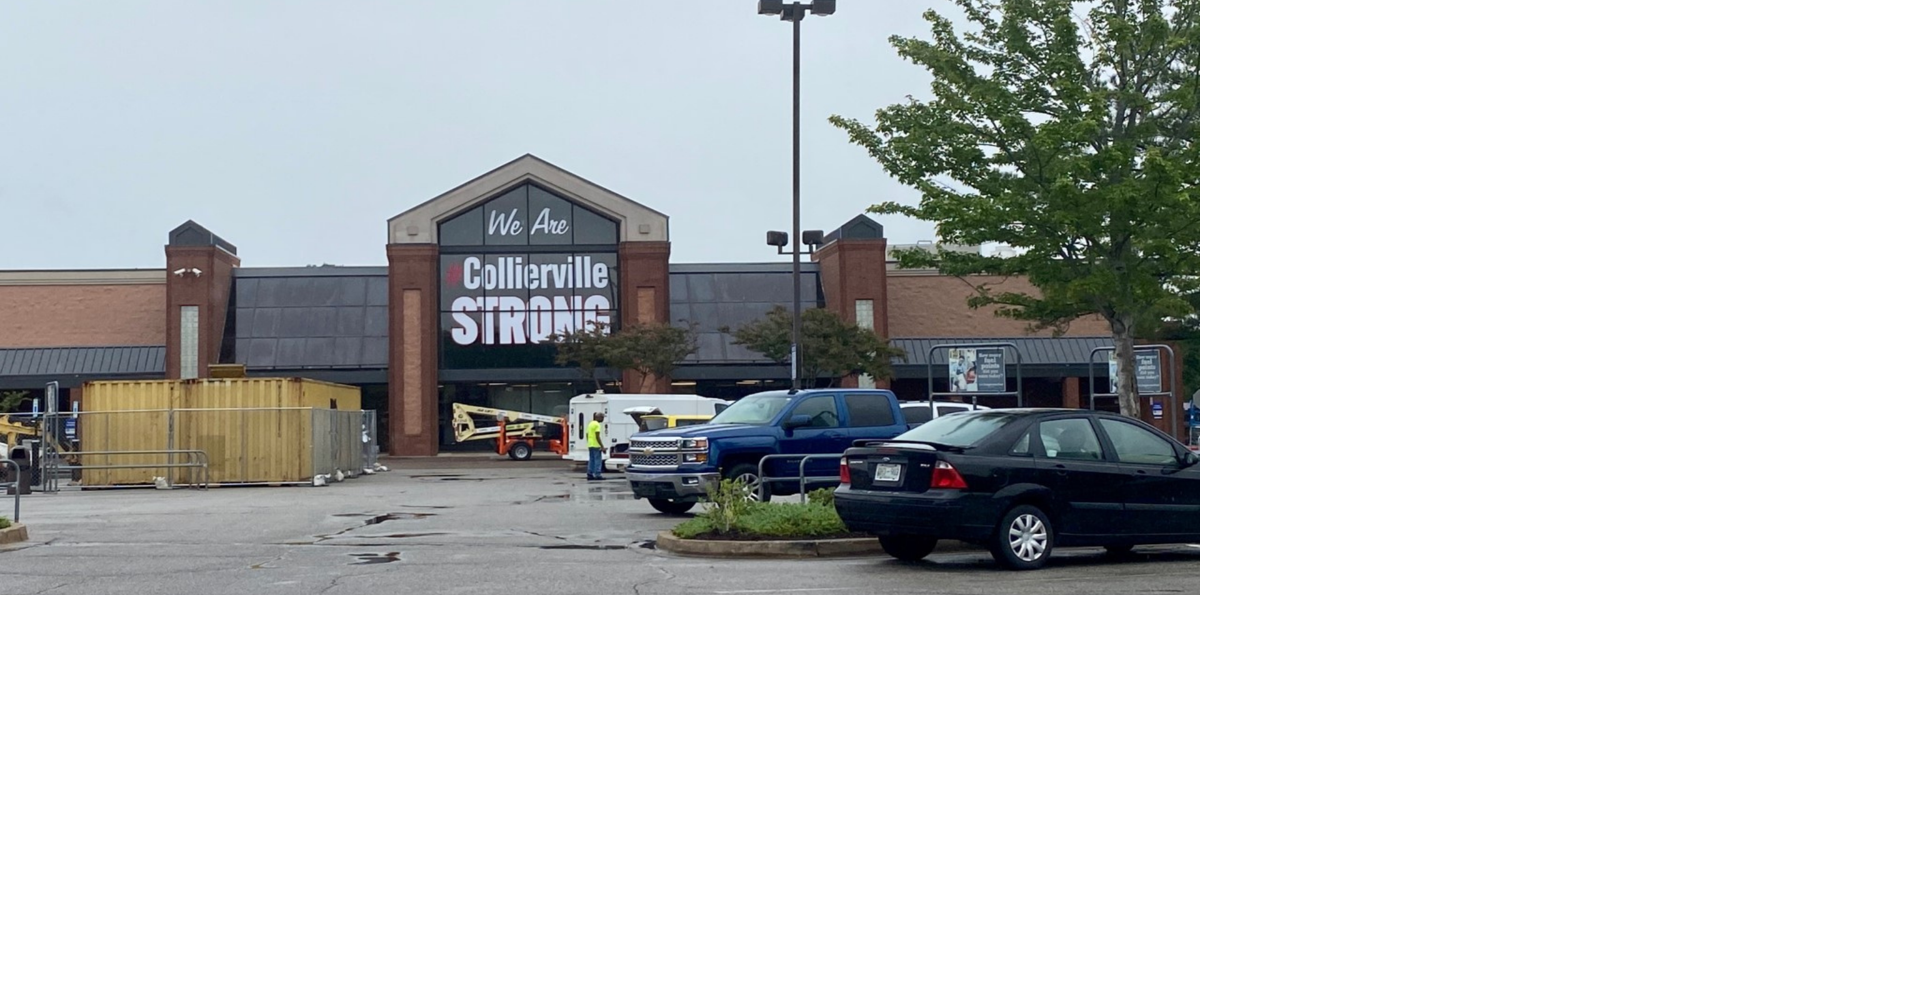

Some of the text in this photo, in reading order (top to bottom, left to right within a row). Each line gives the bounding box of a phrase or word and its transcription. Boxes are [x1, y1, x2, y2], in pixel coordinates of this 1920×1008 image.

[488, 207, 569, 236] We Are
[451, 294, 611, 346] STRONG
